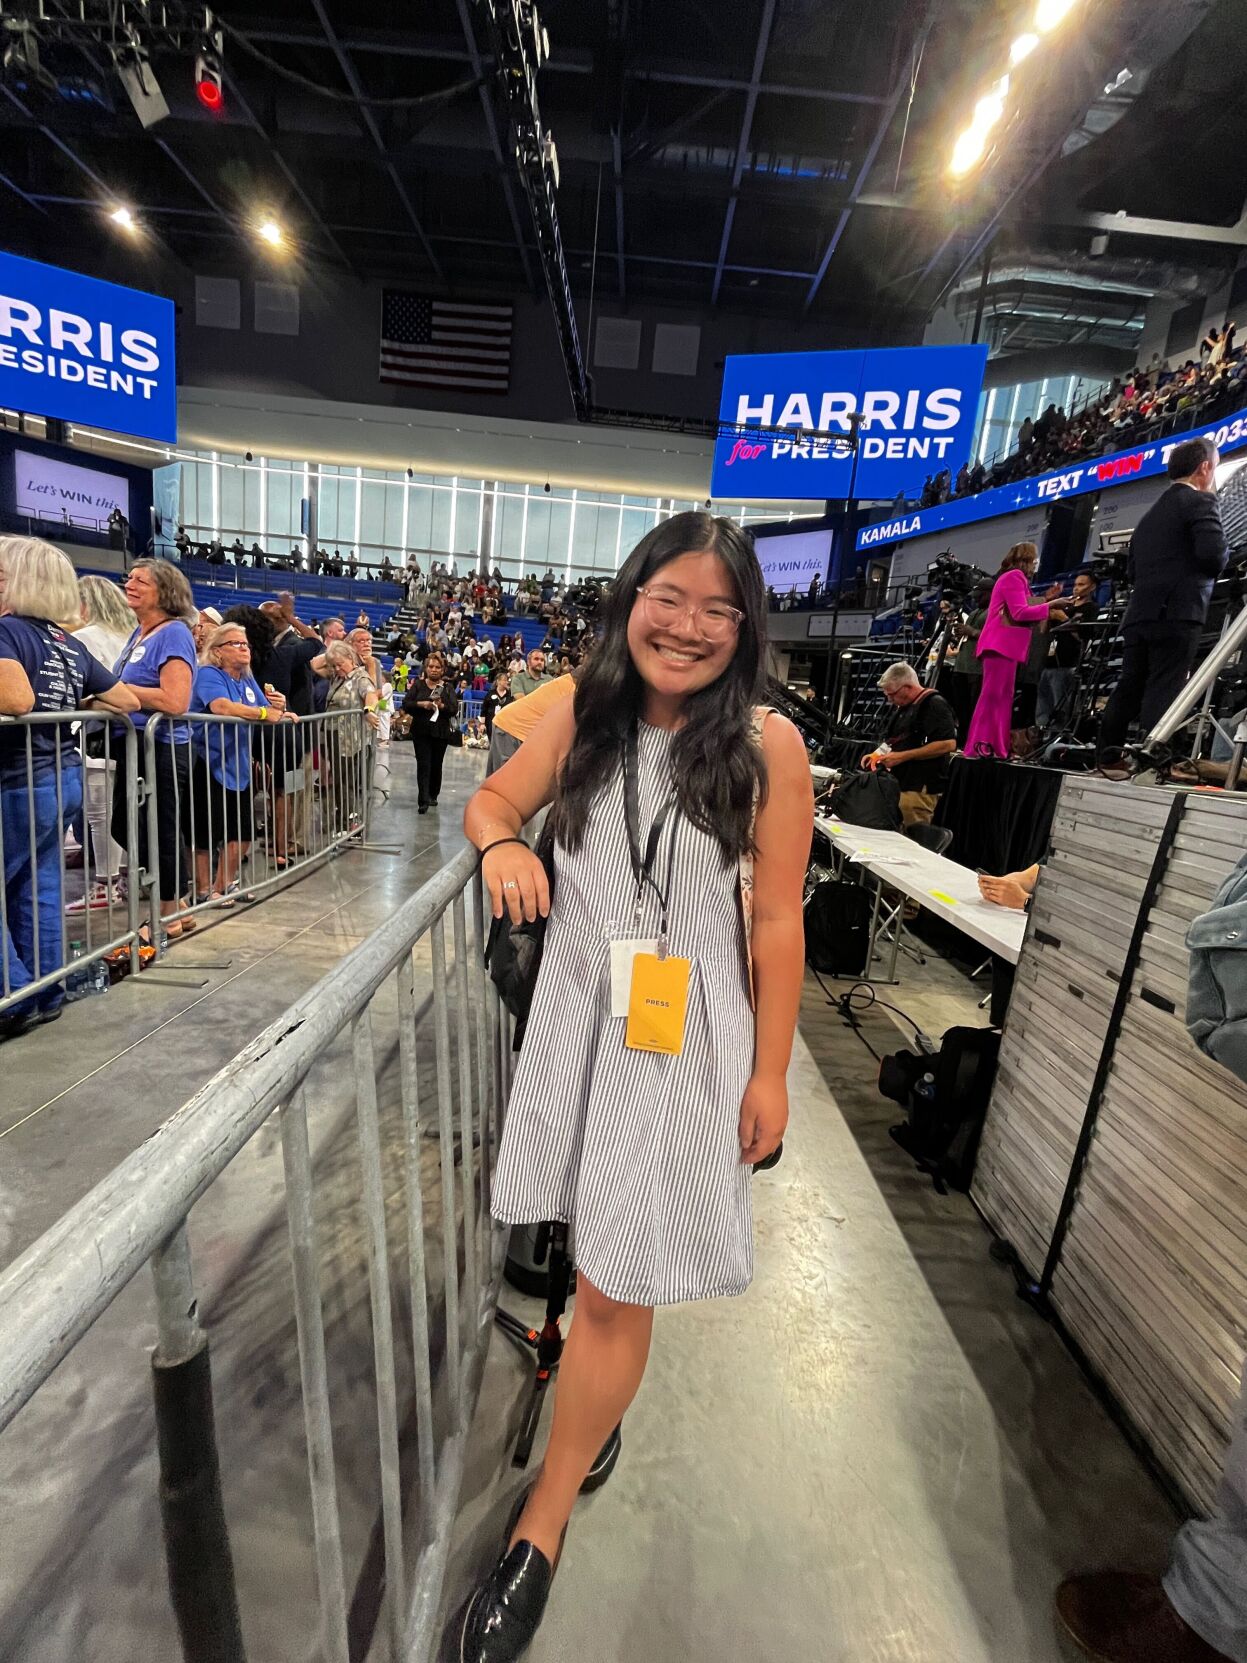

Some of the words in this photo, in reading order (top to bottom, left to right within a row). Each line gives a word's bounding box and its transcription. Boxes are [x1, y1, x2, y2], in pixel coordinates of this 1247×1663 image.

[0, 295, 160, 372] RRIS
[0, 343, 158, 400] ESIDENT
[735, 388, 962, 434] HARRIS
[725, 438, 767, 466] for
[27, 480, 57, 497] Let's
[60, 488, 92, 505] WIN
[1037, 469, 1084, 498] TEXT
[861, 516, 921, 545] KAMALA
[778, 560, 801, 571] WIN
[645, 998, 670, 1008] PRESS
